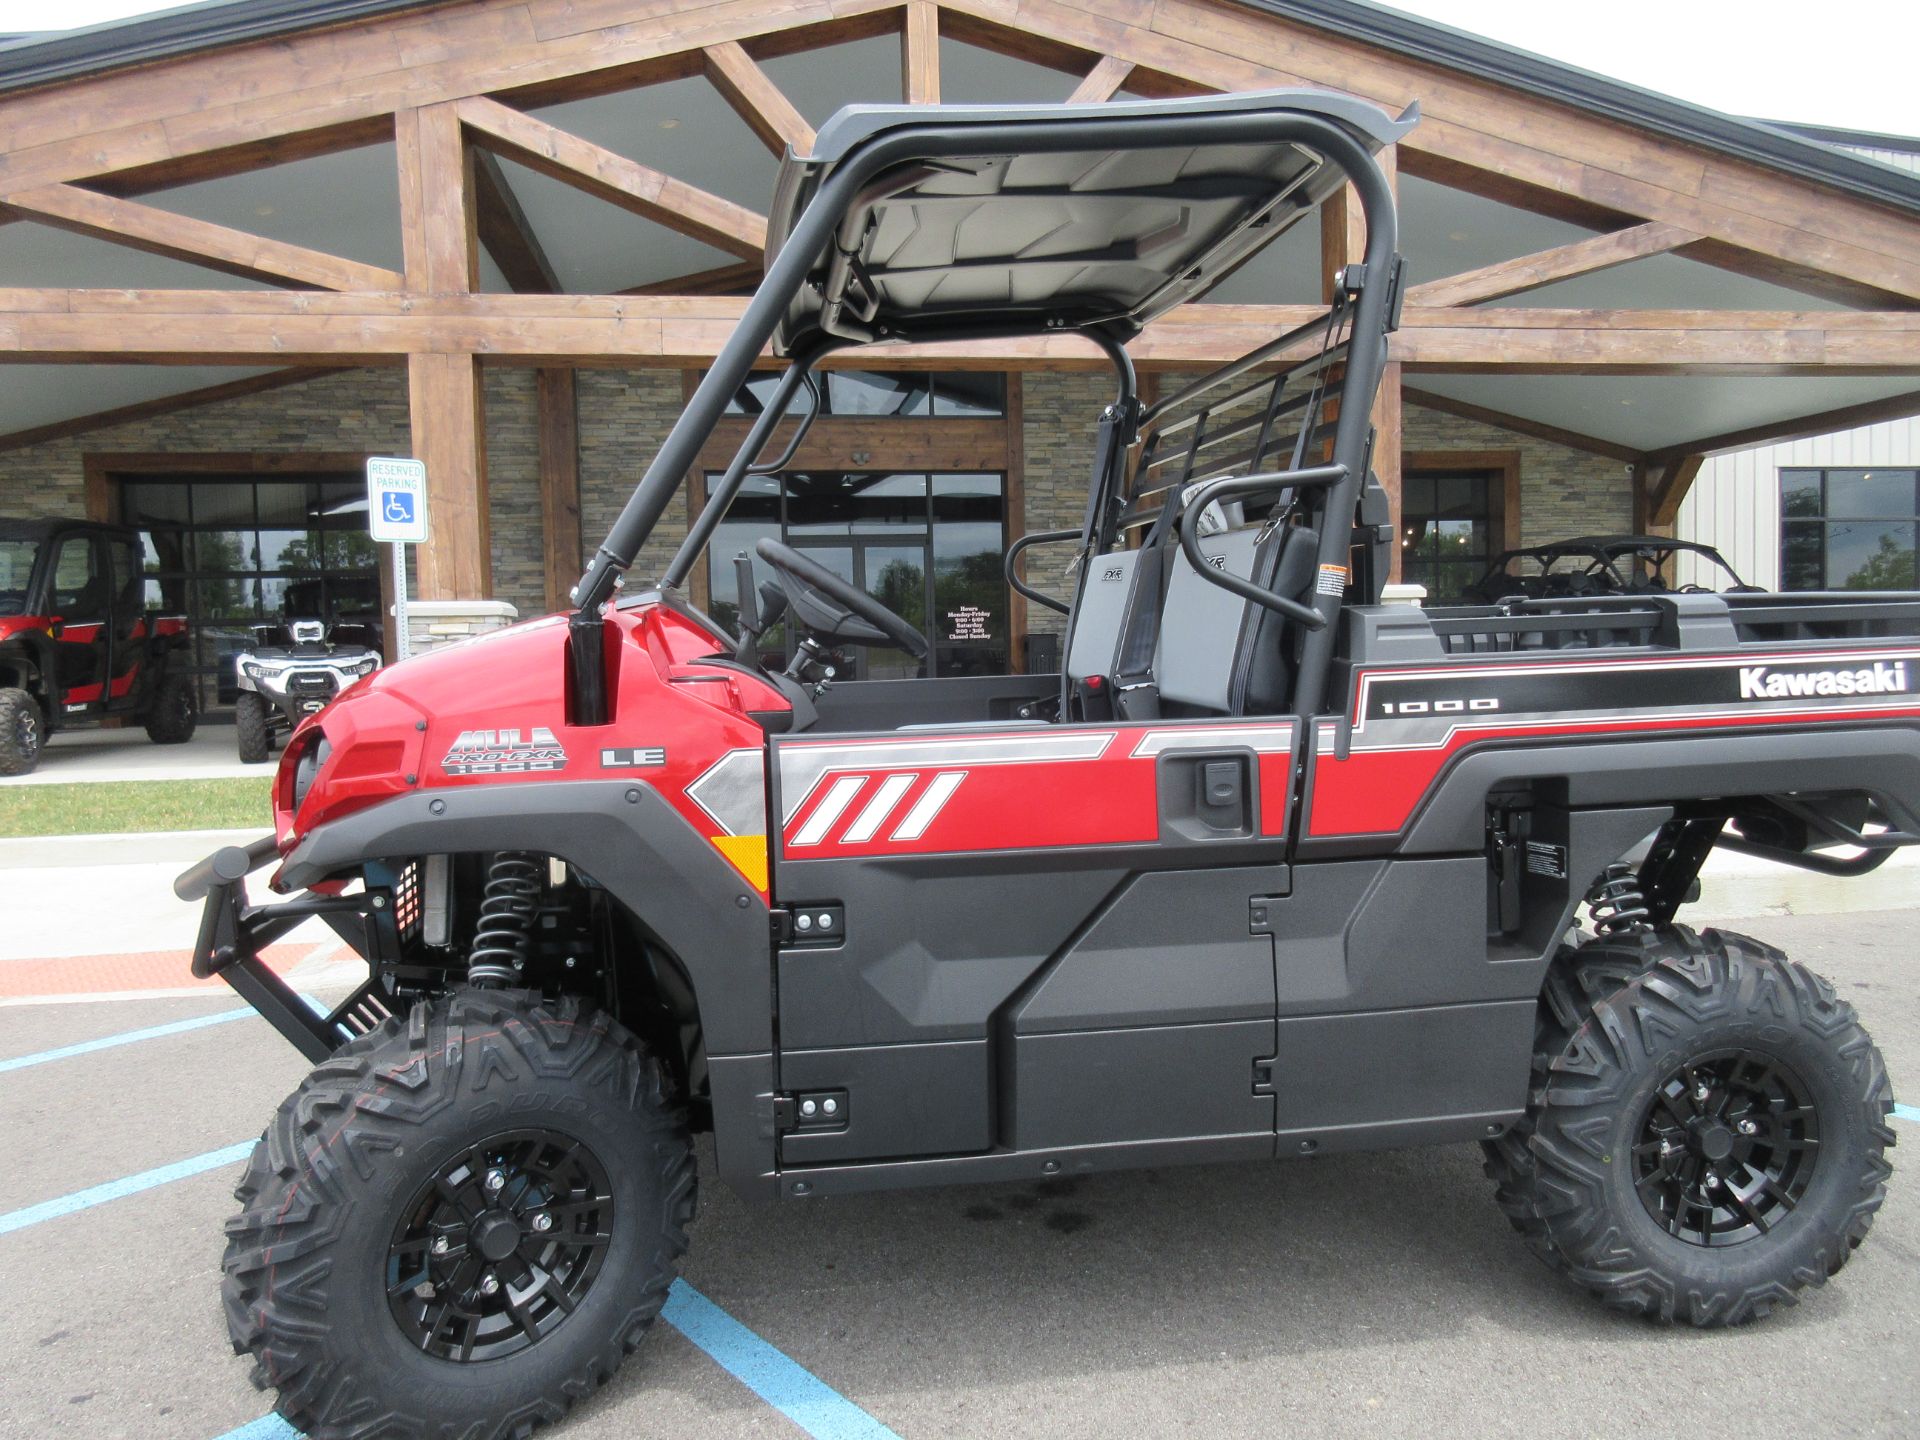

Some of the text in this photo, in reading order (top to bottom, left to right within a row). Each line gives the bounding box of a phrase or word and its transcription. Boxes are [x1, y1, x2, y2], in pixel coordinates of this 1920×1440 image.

[372, 463, 421, 477] RESERVED
[376, 477, 417, 490] PARKING
[1102, 568, 1123, 581] FXR
[1739, 661, 1906, 699] Kawasaki
[1382, 698, 1499, 714] 1000
[448, 727, 563, 753] MULE
[441, 749, 567, 764] PRO-FXR
[602, 749, 664, 766] LE
[458, 761, 555, 774] 1000
